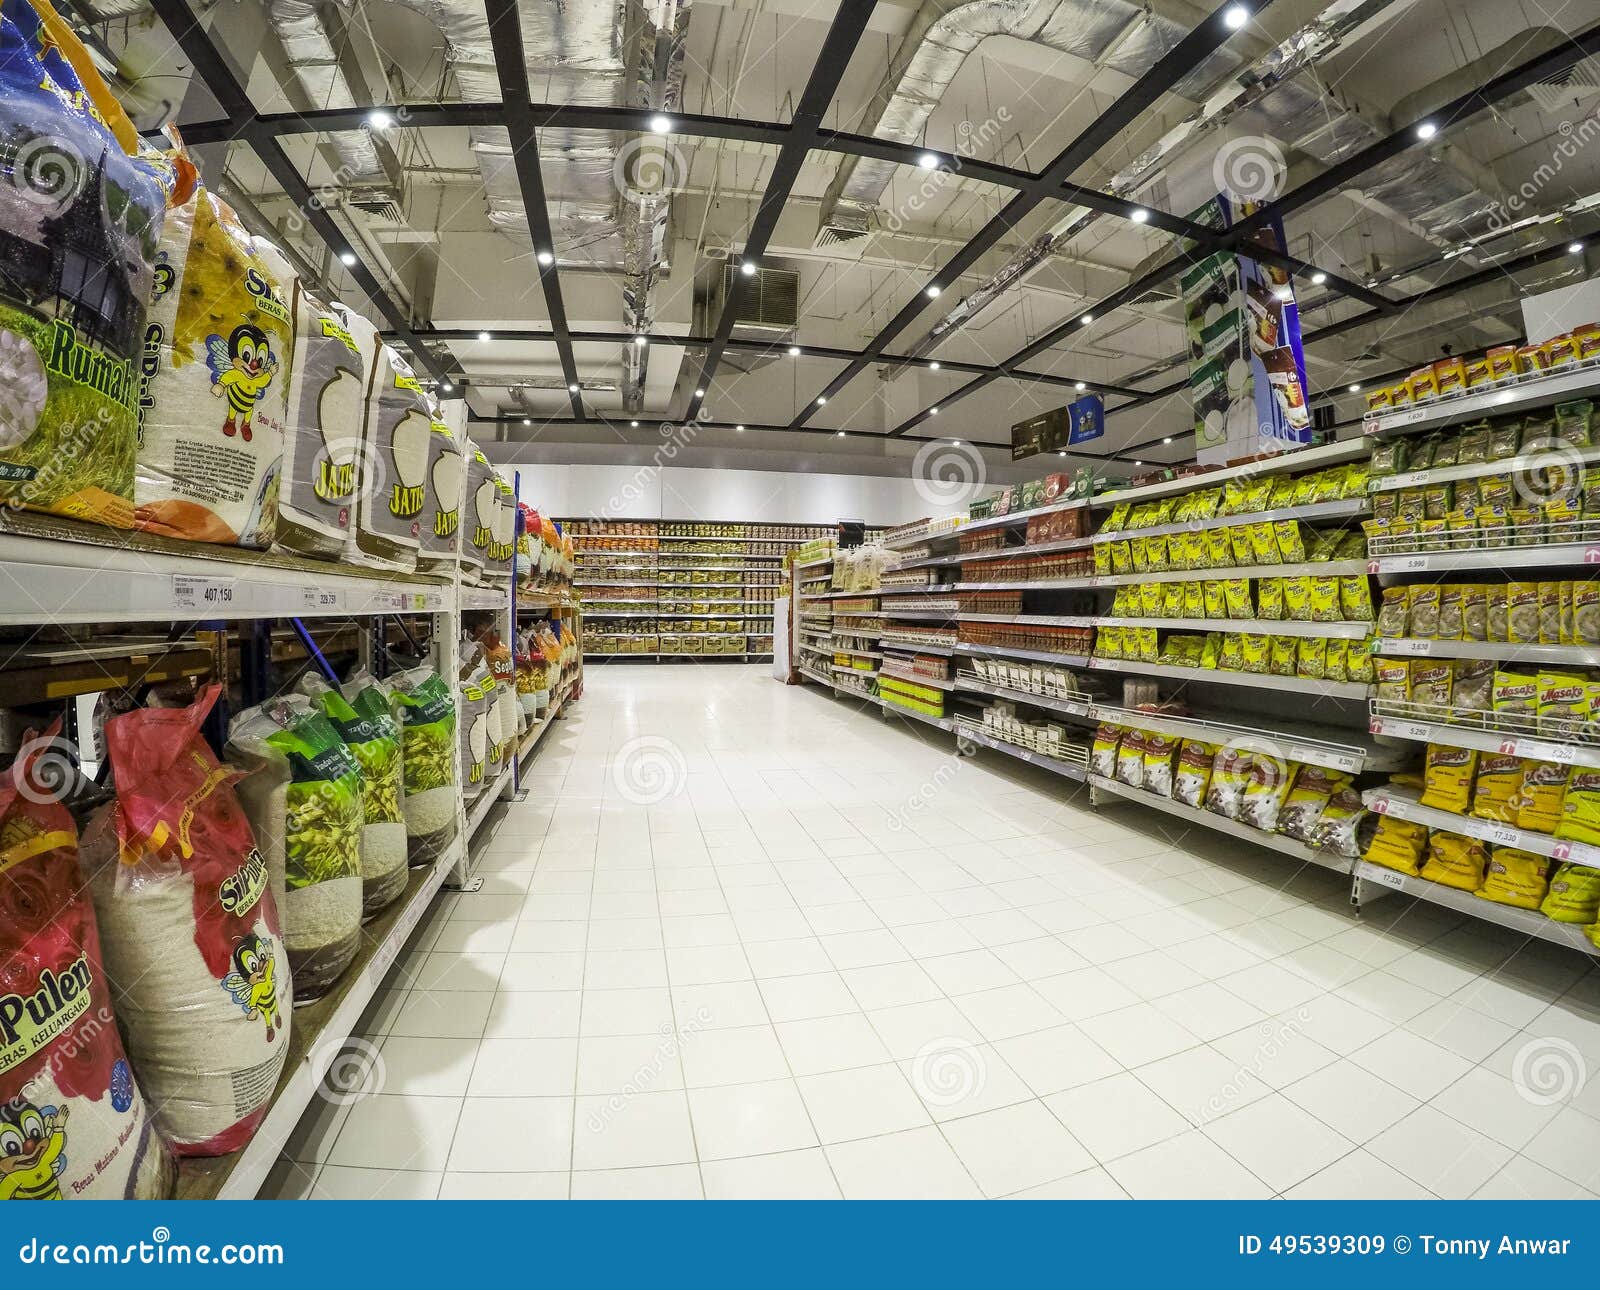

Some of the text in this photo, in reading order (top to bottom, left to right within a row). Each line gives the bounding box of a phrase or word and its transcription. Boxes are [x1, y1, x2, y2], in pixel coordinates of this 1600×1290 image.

[46, 319, 132, 412] Rumah
[204, 587, 233, 603] 407,150
[1496, 683, 1537, 698] Masako
[1541, 685, 1584, 701] Masako
[1572, 773, 1600, 788] Mas
[0, 957, 92, 1046] Pulen
[0, 994, 89, 1070] ERAS KELUARGAKU
